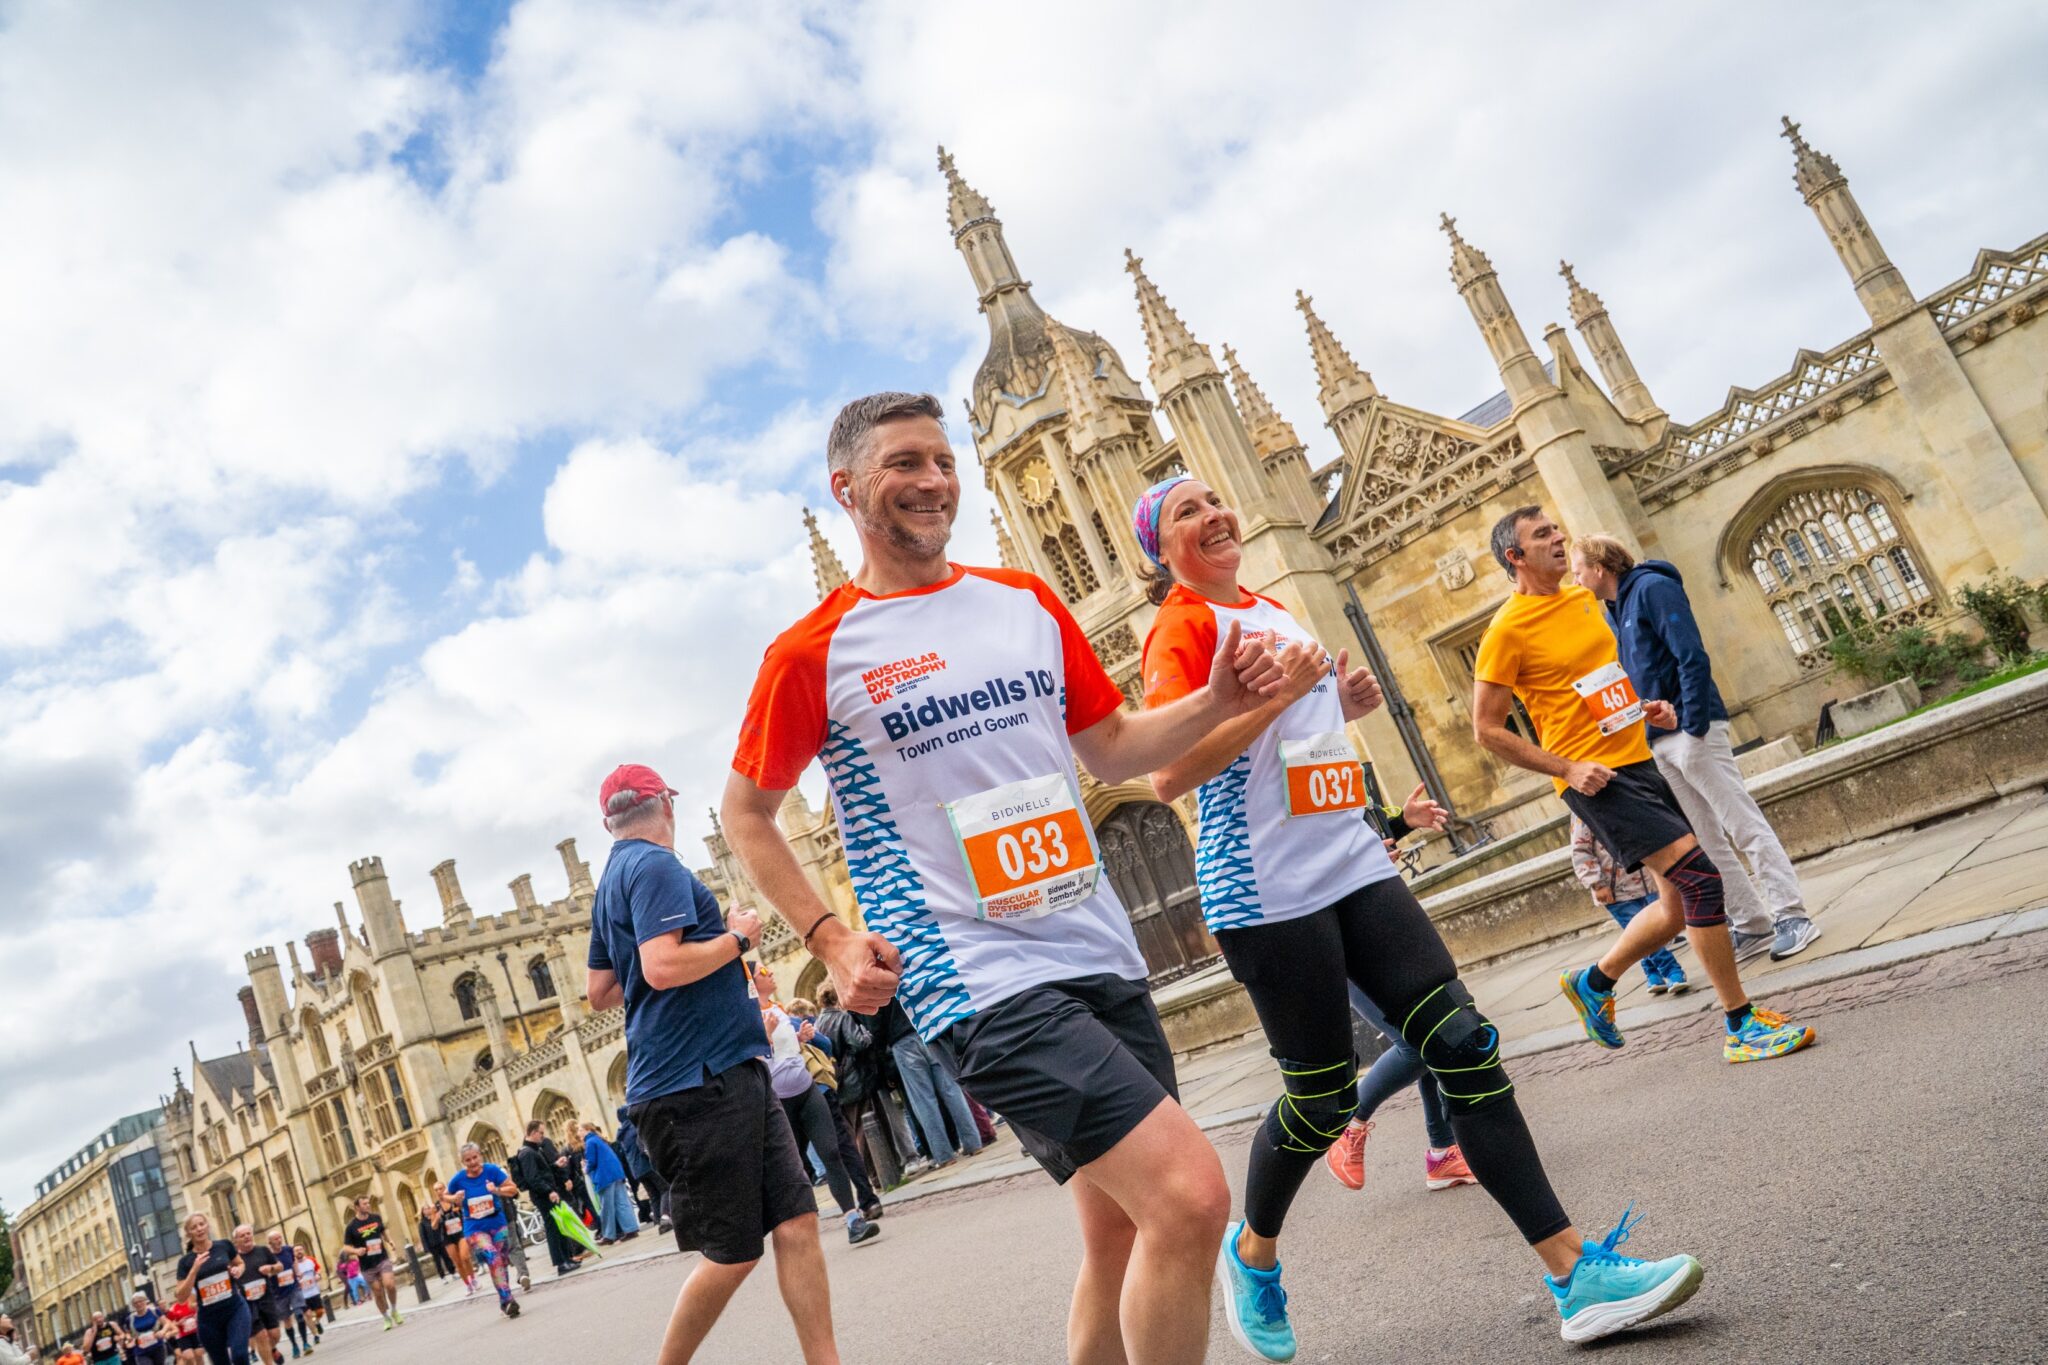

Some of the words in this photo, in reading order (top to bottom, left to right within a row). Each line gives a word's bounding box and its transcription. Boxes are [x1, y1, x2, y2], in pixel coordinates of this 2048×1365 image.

[862, 652, 939, 684] MUSCULAR
[866, 660, 946, 694] DYSTROPHY
[897, 684, 917, 694] MATTER
[907, 675, 930, 686] MUSCLES
[871, 689, 894, 705] UK
[1601, 683, 1629, 711] 467
[880, 677, 1027, 742] Bidwells
[896, 736, 944, 762] Town
[946, 721, 982, 744] and
[984, 712, 1029, 732] Gown
[1310, 747, 1347, 759] BIDWELLS
[1309, 766, 1356, 808] 032
[991, 797, 1051, 821] BIDWELLS
[996, 821, 1069, 881] 033
[988, 889, 1040, 906] MUSCULAR
[1048, 881, 1076, 895] Bidwells
[988, 896, 1043, 912] DYSTROPHY
